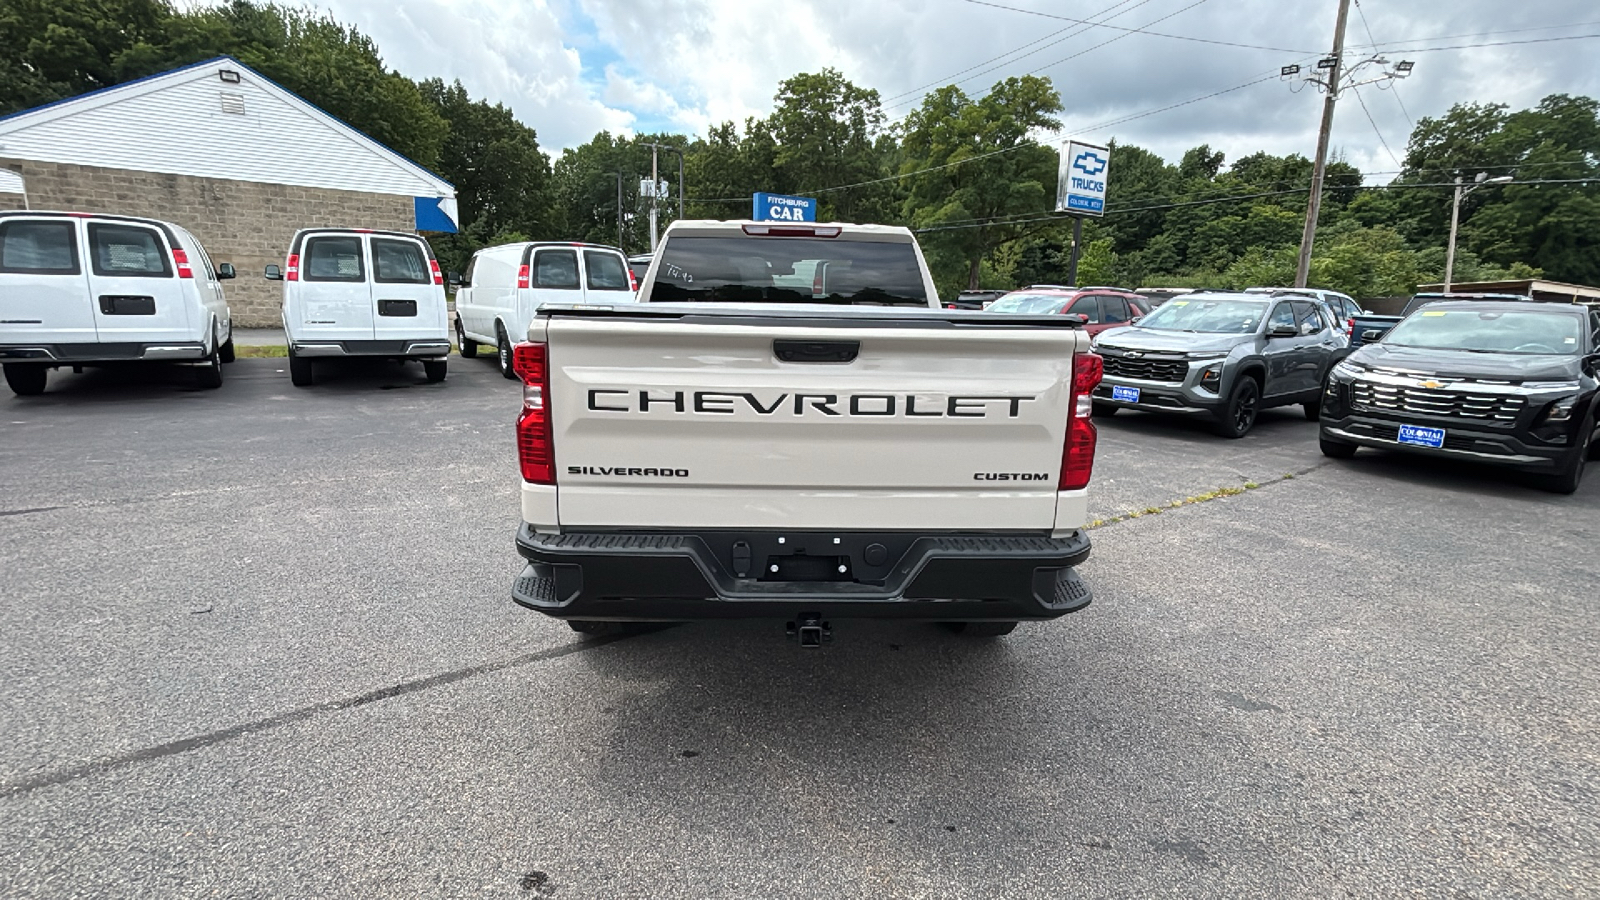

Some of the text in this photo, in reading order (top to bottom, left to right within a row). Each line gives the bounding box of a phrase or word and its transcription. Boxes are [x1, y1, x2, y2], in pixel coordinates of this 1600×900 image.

[1072, 177, 1104, 192] TRUCKS
[767, 196, 809, 207] FITCHBURG
[770, 206, 804, 221] CAR
[588, 389, 1036, 417] CHEVROLET
[1401, 428, 1441, 439] COLONIAL
[567, 465, 689, 478] SILVERADO
[973, 472, 1050, 482] CUSTOM
